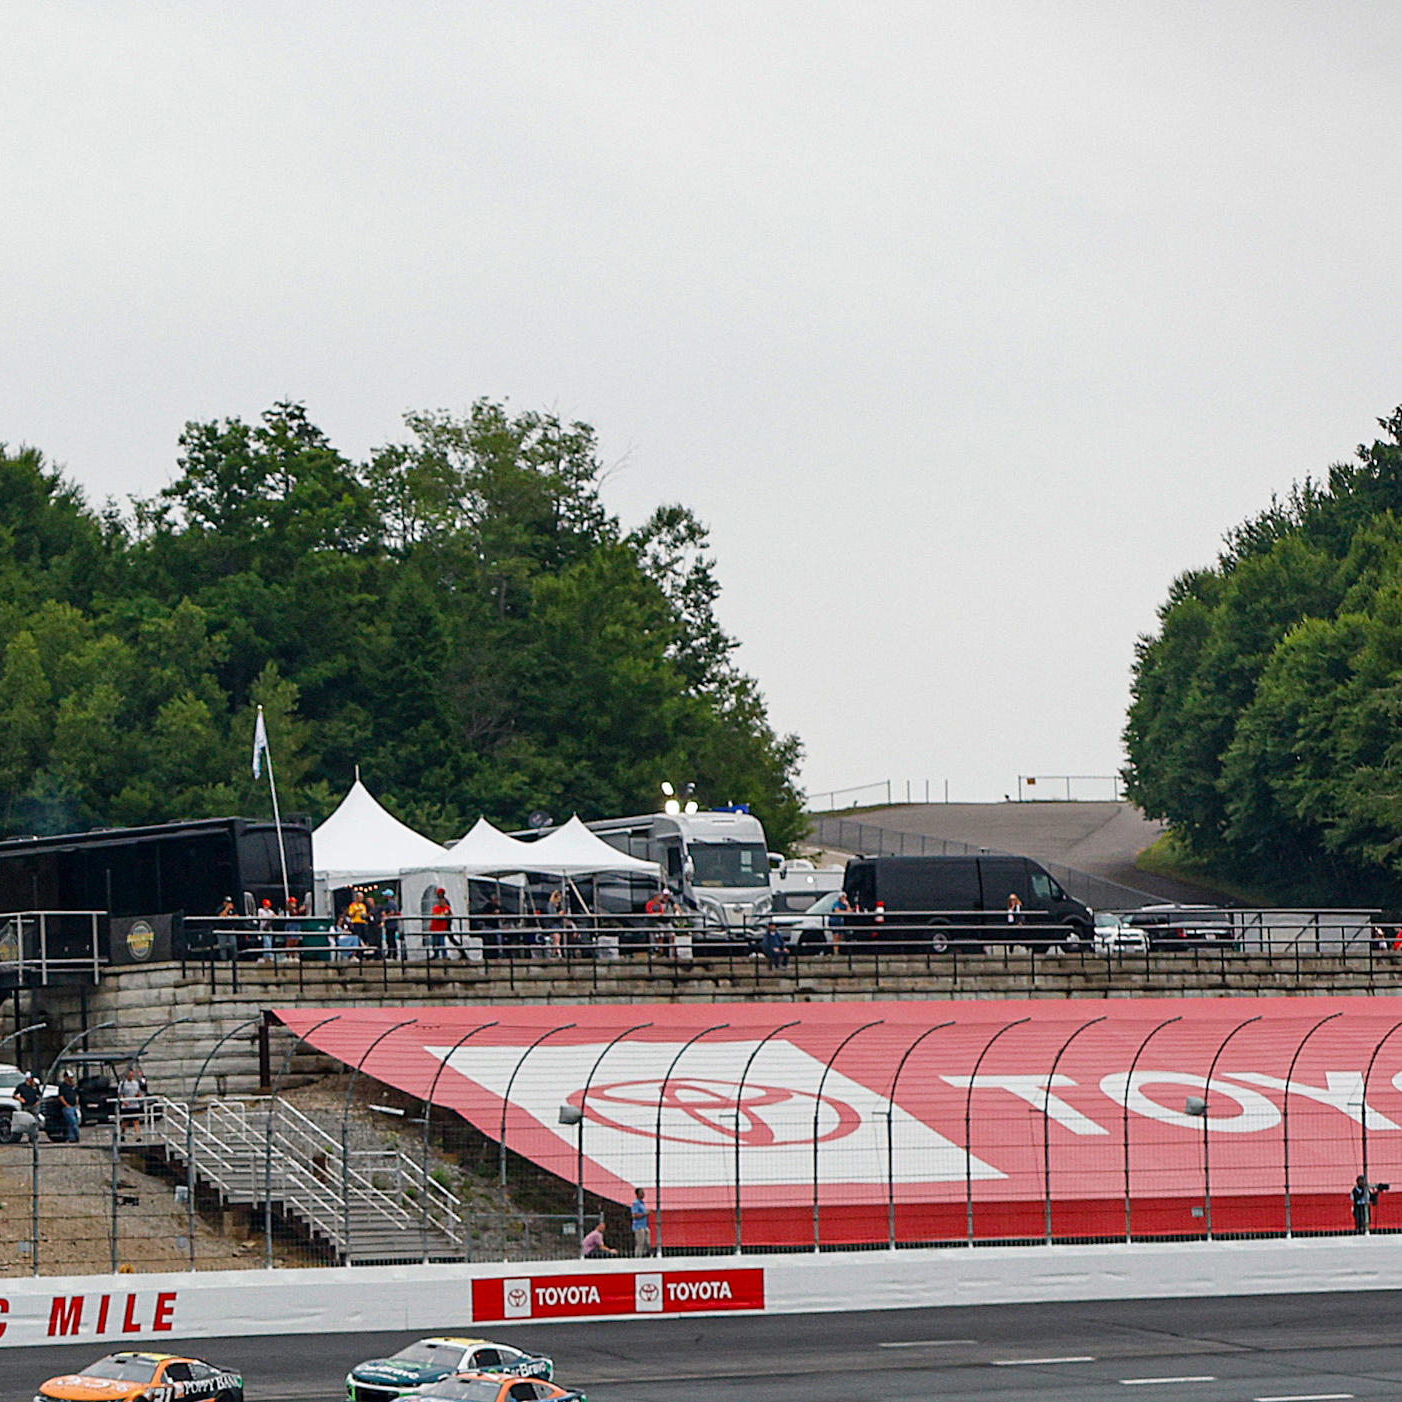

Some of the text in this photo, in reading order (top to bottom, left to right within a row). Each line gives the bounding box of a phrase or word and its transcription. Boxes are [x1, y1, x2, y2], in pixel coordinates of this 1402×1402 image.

[536, 1286, 600, 1305] TOYOTA
[667, 1281, 732, 1301] TOYOTA
[47, 1292, 177, 1336] MILE
[184, 1381, 215, 1394] POPPY
